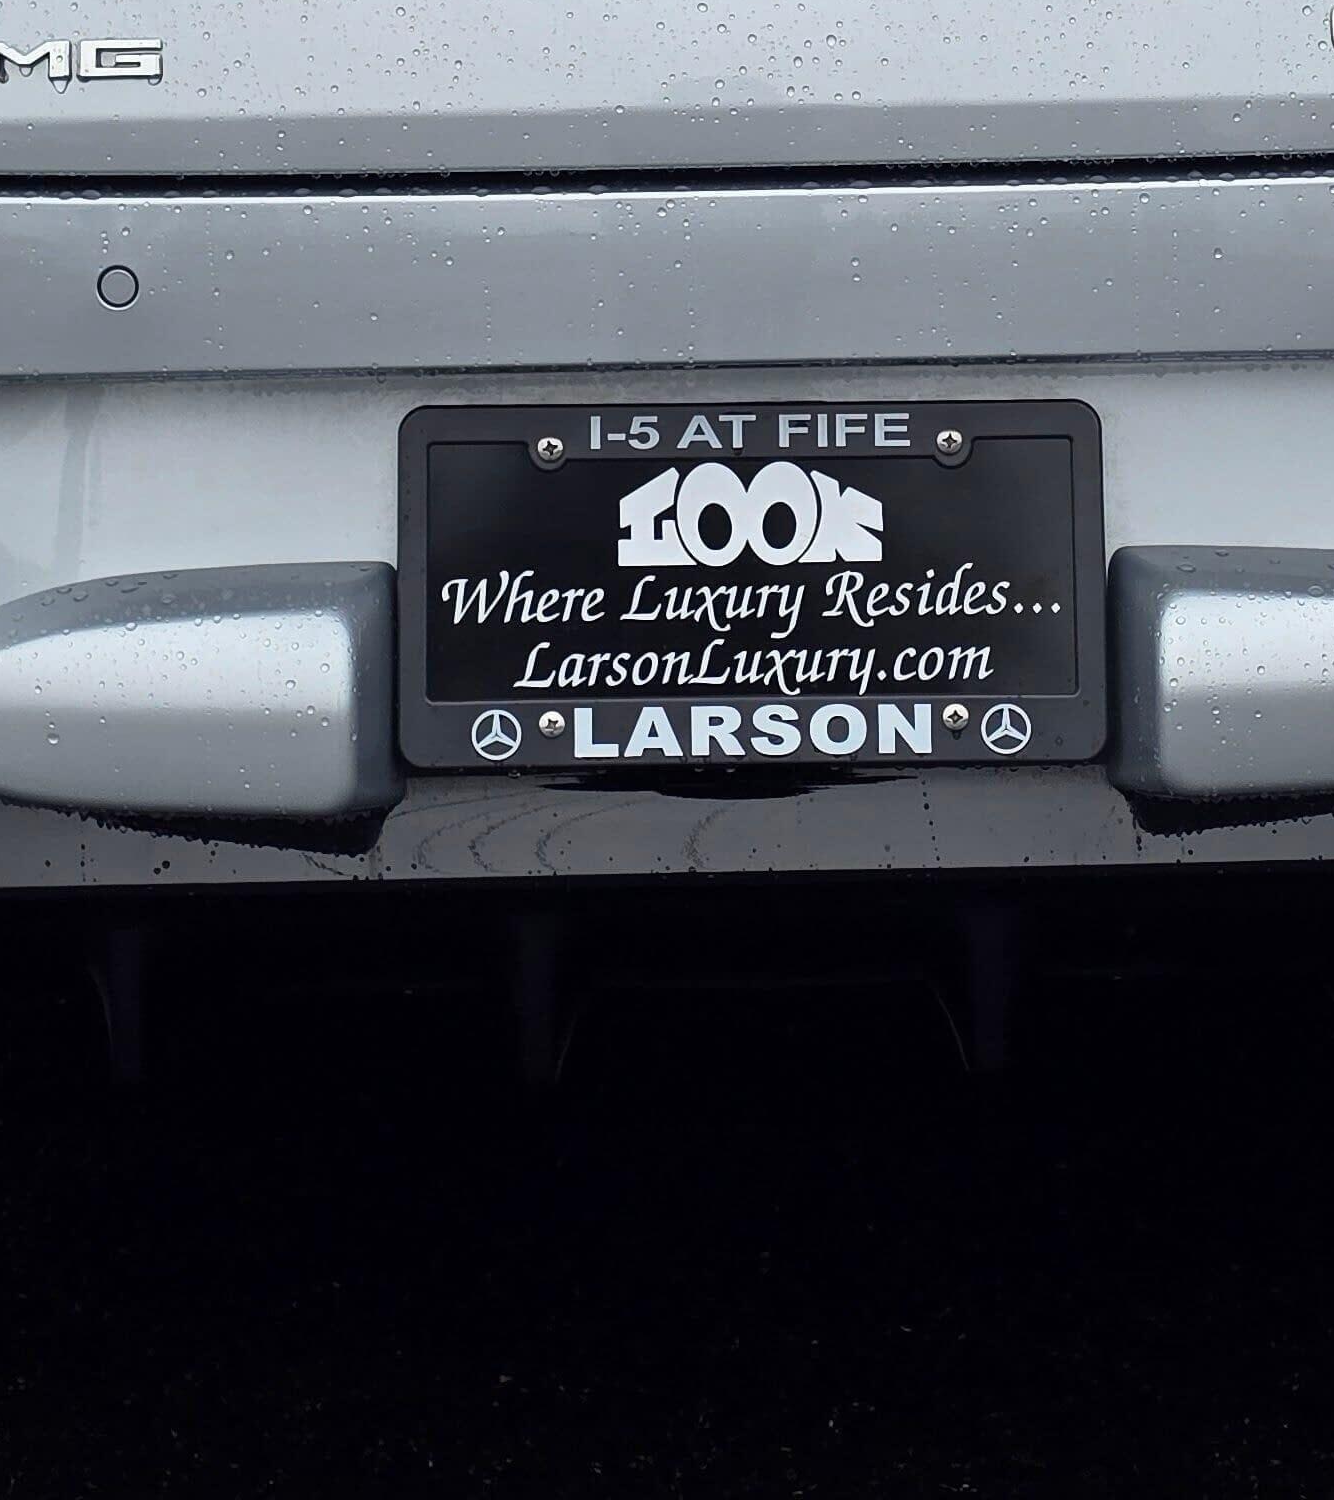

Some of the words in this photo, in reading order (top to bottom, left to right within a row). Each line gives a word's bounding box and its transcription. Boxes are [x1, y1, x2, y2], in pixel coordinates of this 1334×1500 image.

[589, 414, 661, 450] I-5
[676, 414, 756, 450] AT
[778, 413, 911, 448] FIFE
[441, 571, 605, 625] Where
[619, 574, 805, 639] Luxury
[822, 564, 1063, 627] Resides...
[513, 638, 995, 696] LarsonLuxury.com
[572, 702, 934, 759] LARSON
